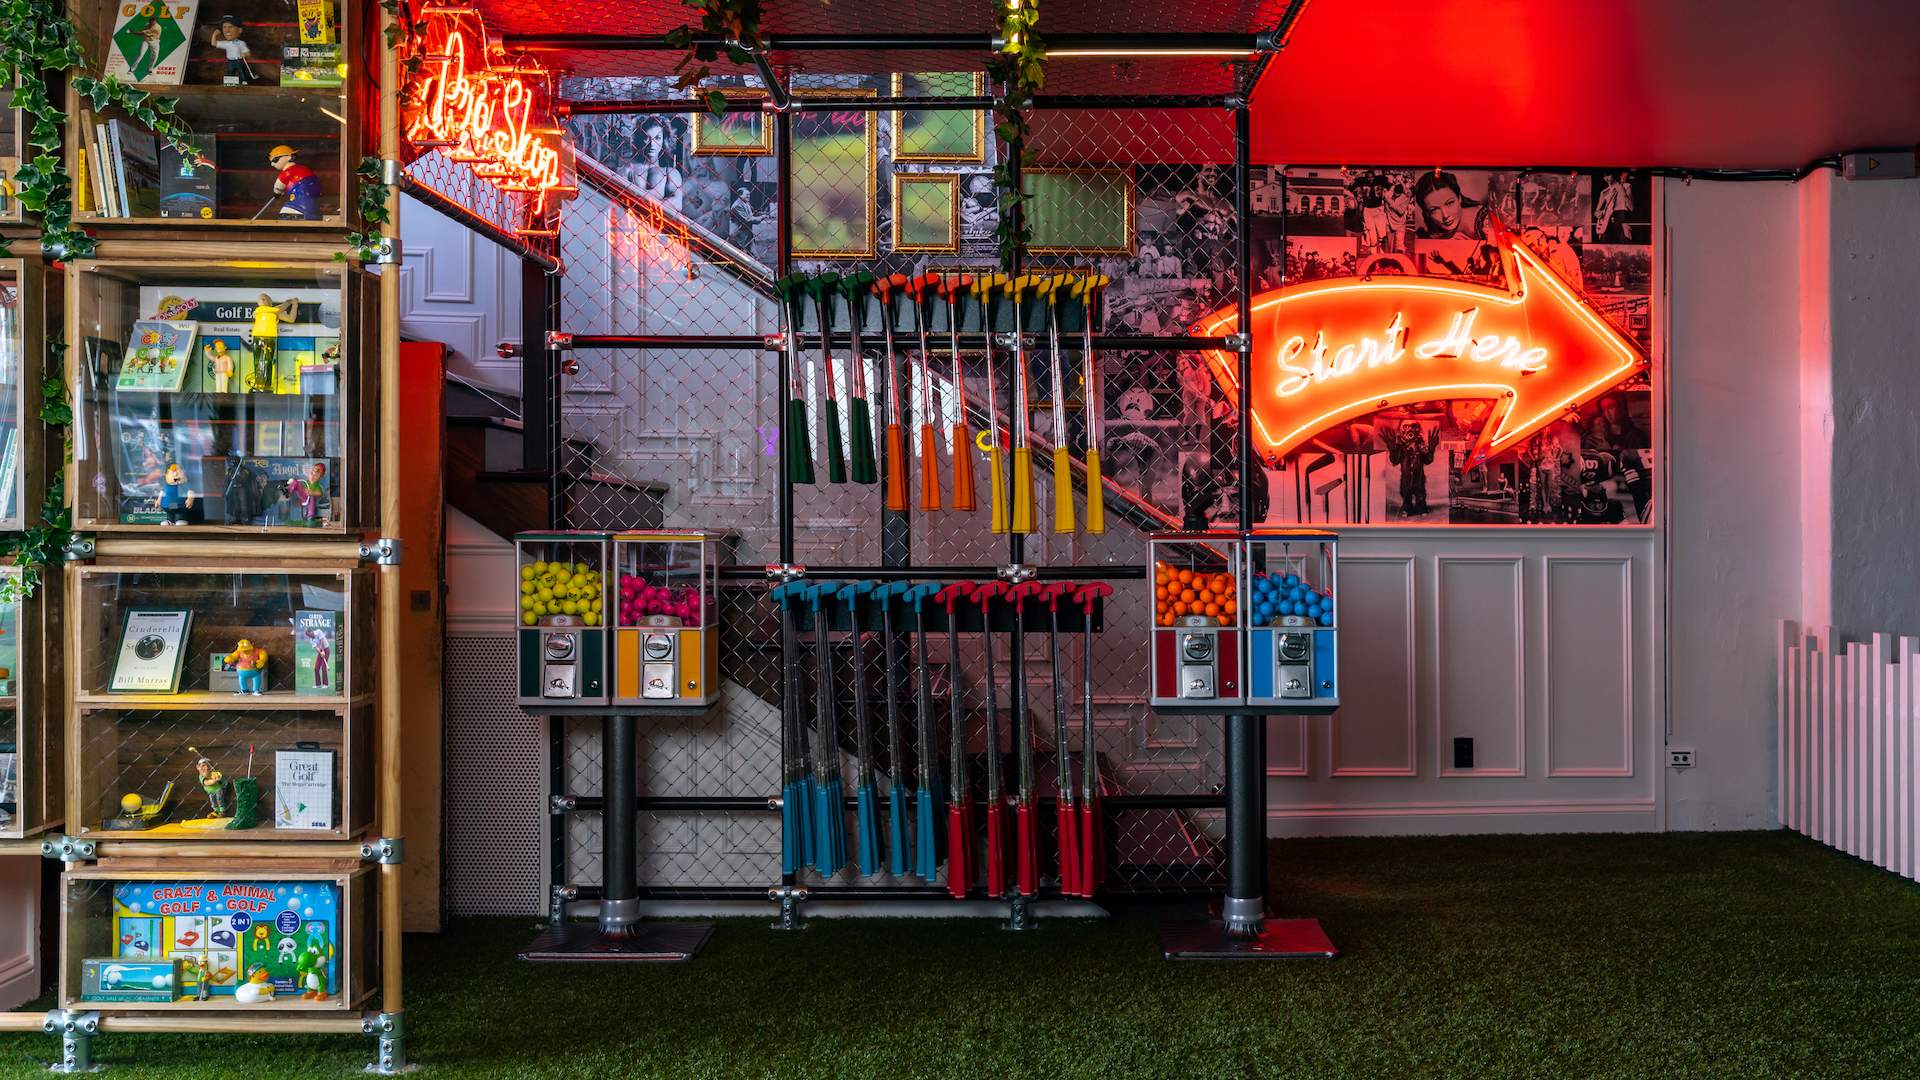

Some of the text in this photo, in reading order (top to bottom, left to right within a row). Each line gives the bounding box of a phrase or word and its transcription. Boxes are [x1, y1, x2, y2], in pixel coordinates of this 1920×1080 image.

[122, 4, 190, 20] GOLF
[494, 78, 560, 215] Shop
[216, 306, 242, 319] Golf
[1275, 306, 1547, 397] Start Here
[272, 463, 299, 475] Angel
[128, 625, 180, 633] Cinderella
[300, 619, 332, 628] STRANGE
[118, 676, 168, 685] Bill Murray
[289, 761, 318, 771] Great
[292, 771, 315, 781] Golf
[153, 884, 276, 902] CRAZY & ANIMAL
[160, 899, 267, 915] GOLF GOLF
